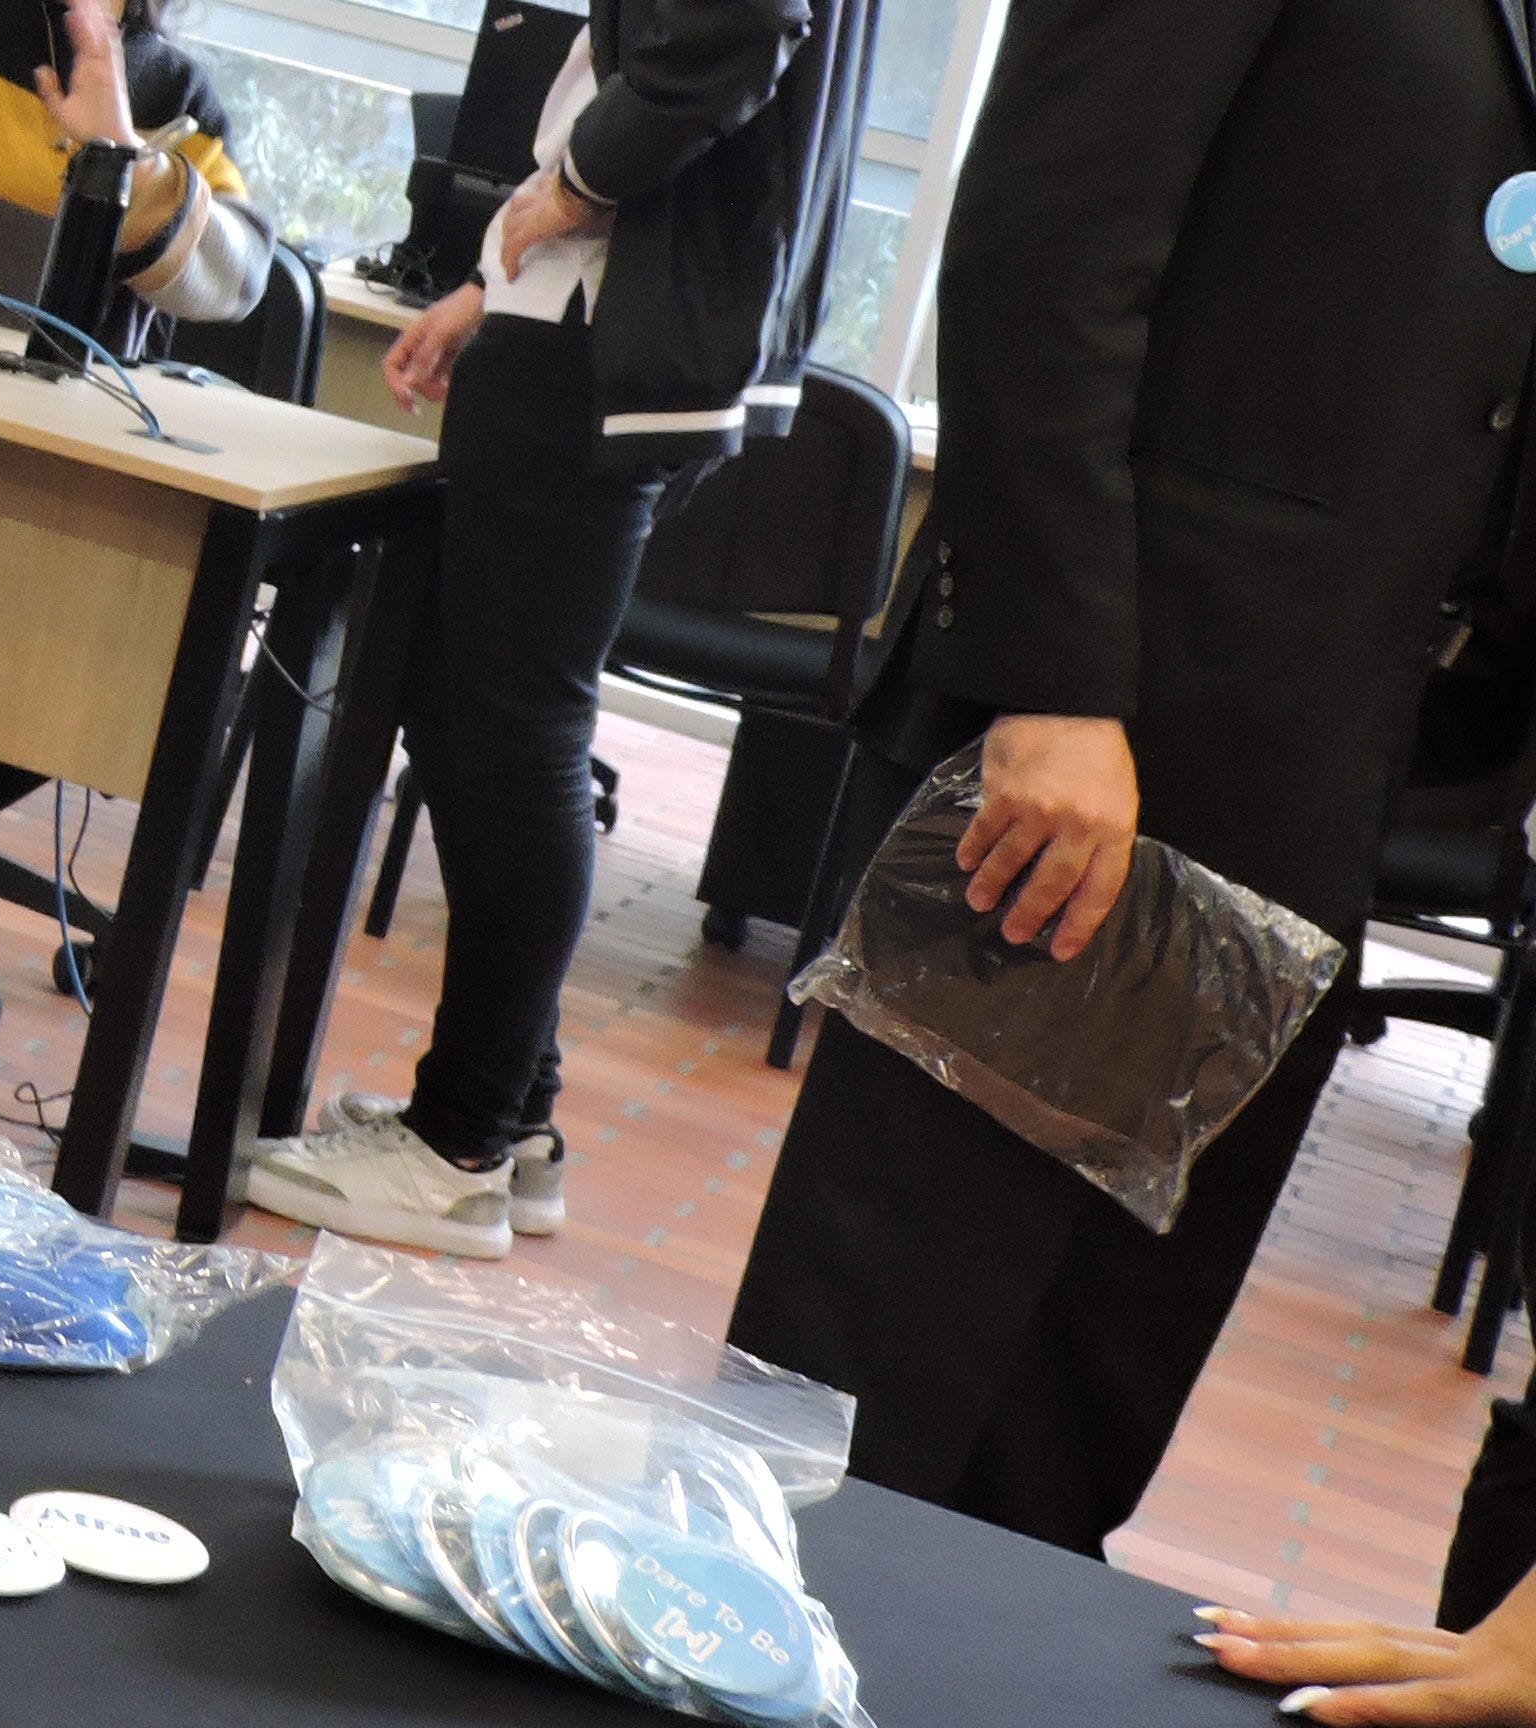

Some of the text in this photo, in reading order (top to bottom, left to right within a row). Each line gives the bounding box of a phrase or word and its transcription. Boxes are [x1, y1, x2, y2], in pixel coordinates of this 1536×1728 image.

[634, 1553, 791, 1666] Dare To Be
